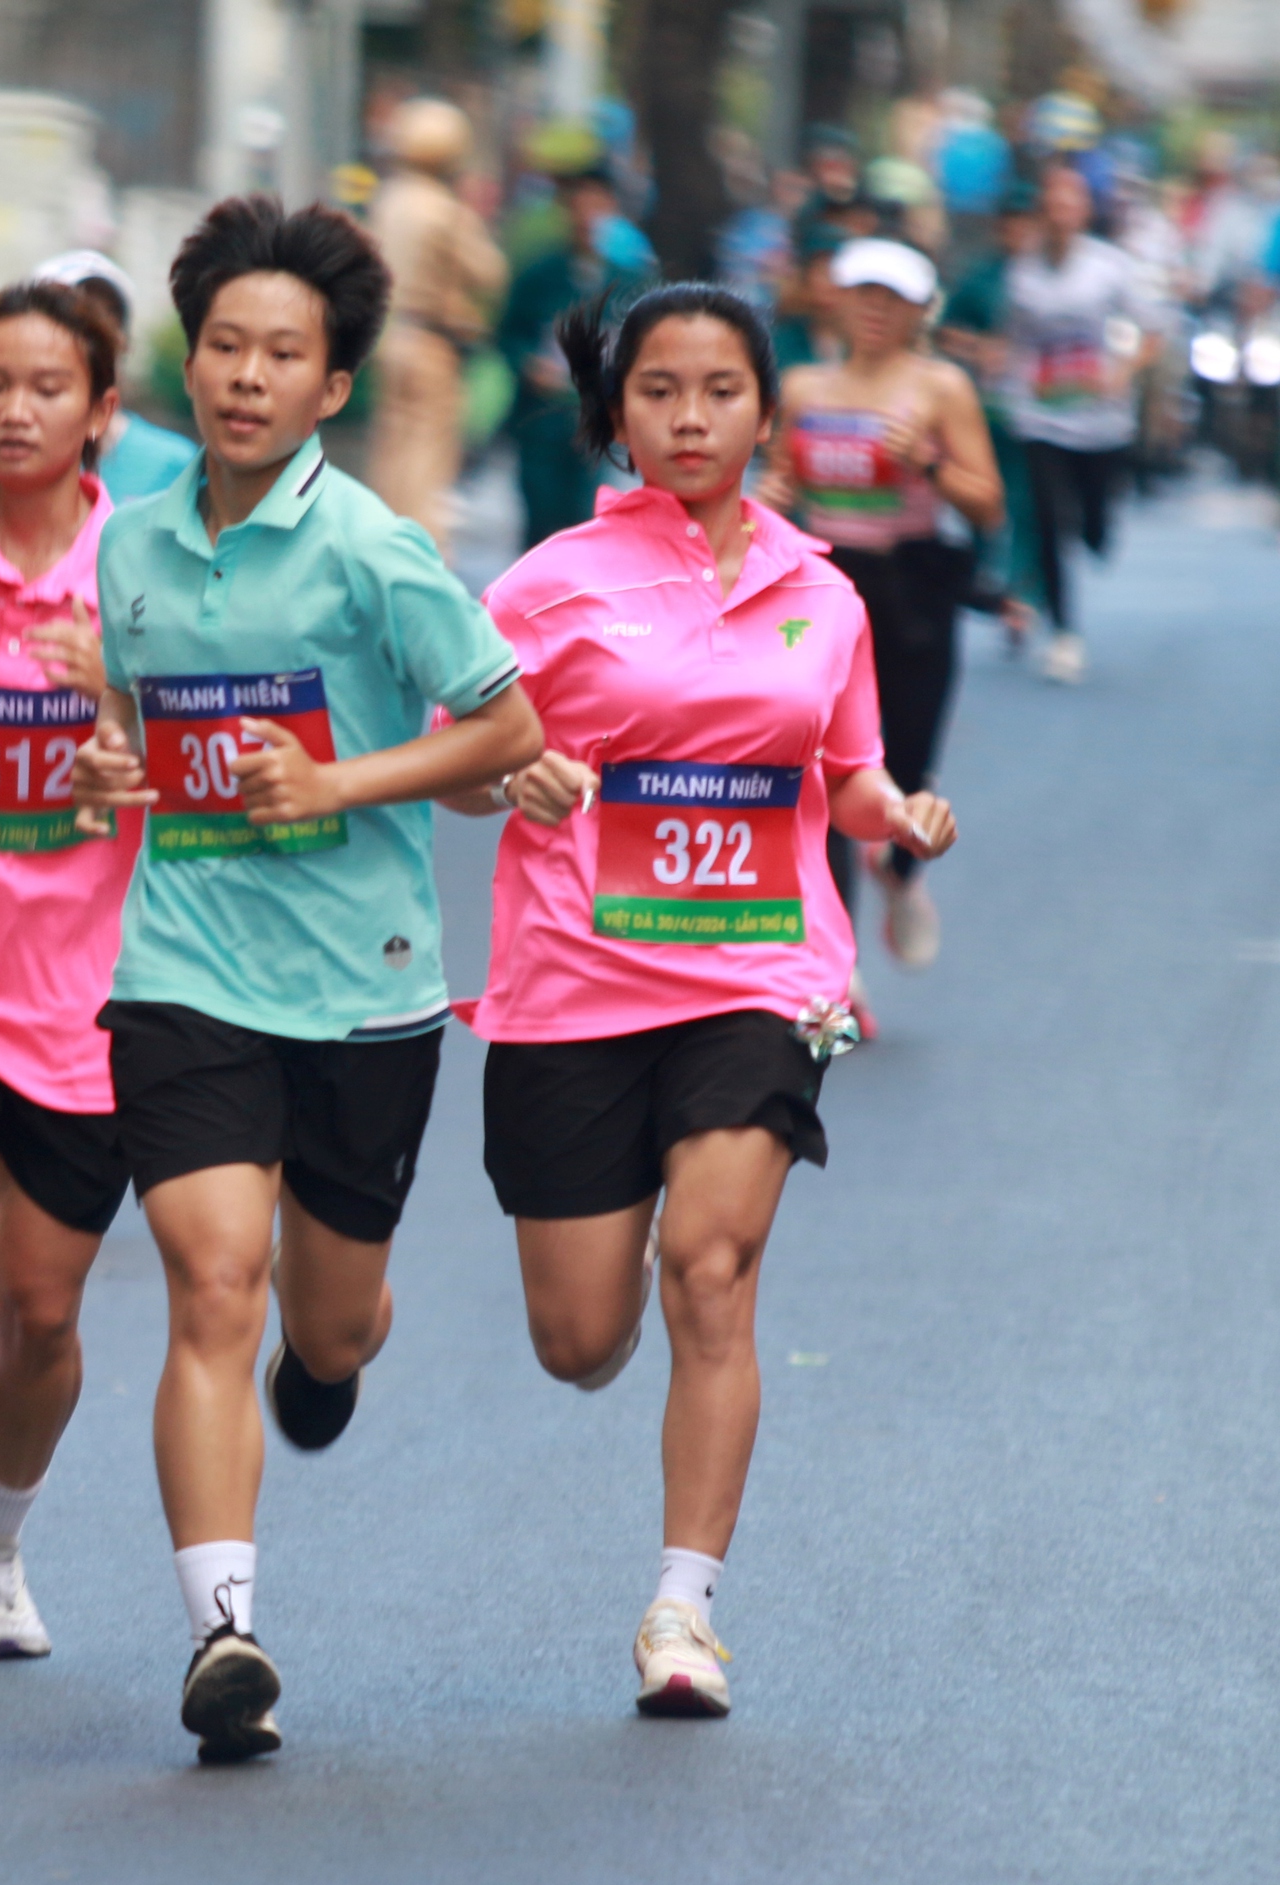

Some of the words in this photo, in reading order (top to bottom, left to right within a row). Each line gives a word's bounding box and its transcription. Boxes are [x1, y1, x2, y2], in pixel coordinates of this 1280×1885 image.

[43, 690, 95, 722] NIÊN
[158, 685, 226, 711] THANH
[233, 679, 290, 707] NIÊN
[638, 772, 725, 799] THANH
[729, 770, 773, 800] NIÊN
[653, 818, 758, 886] 322
